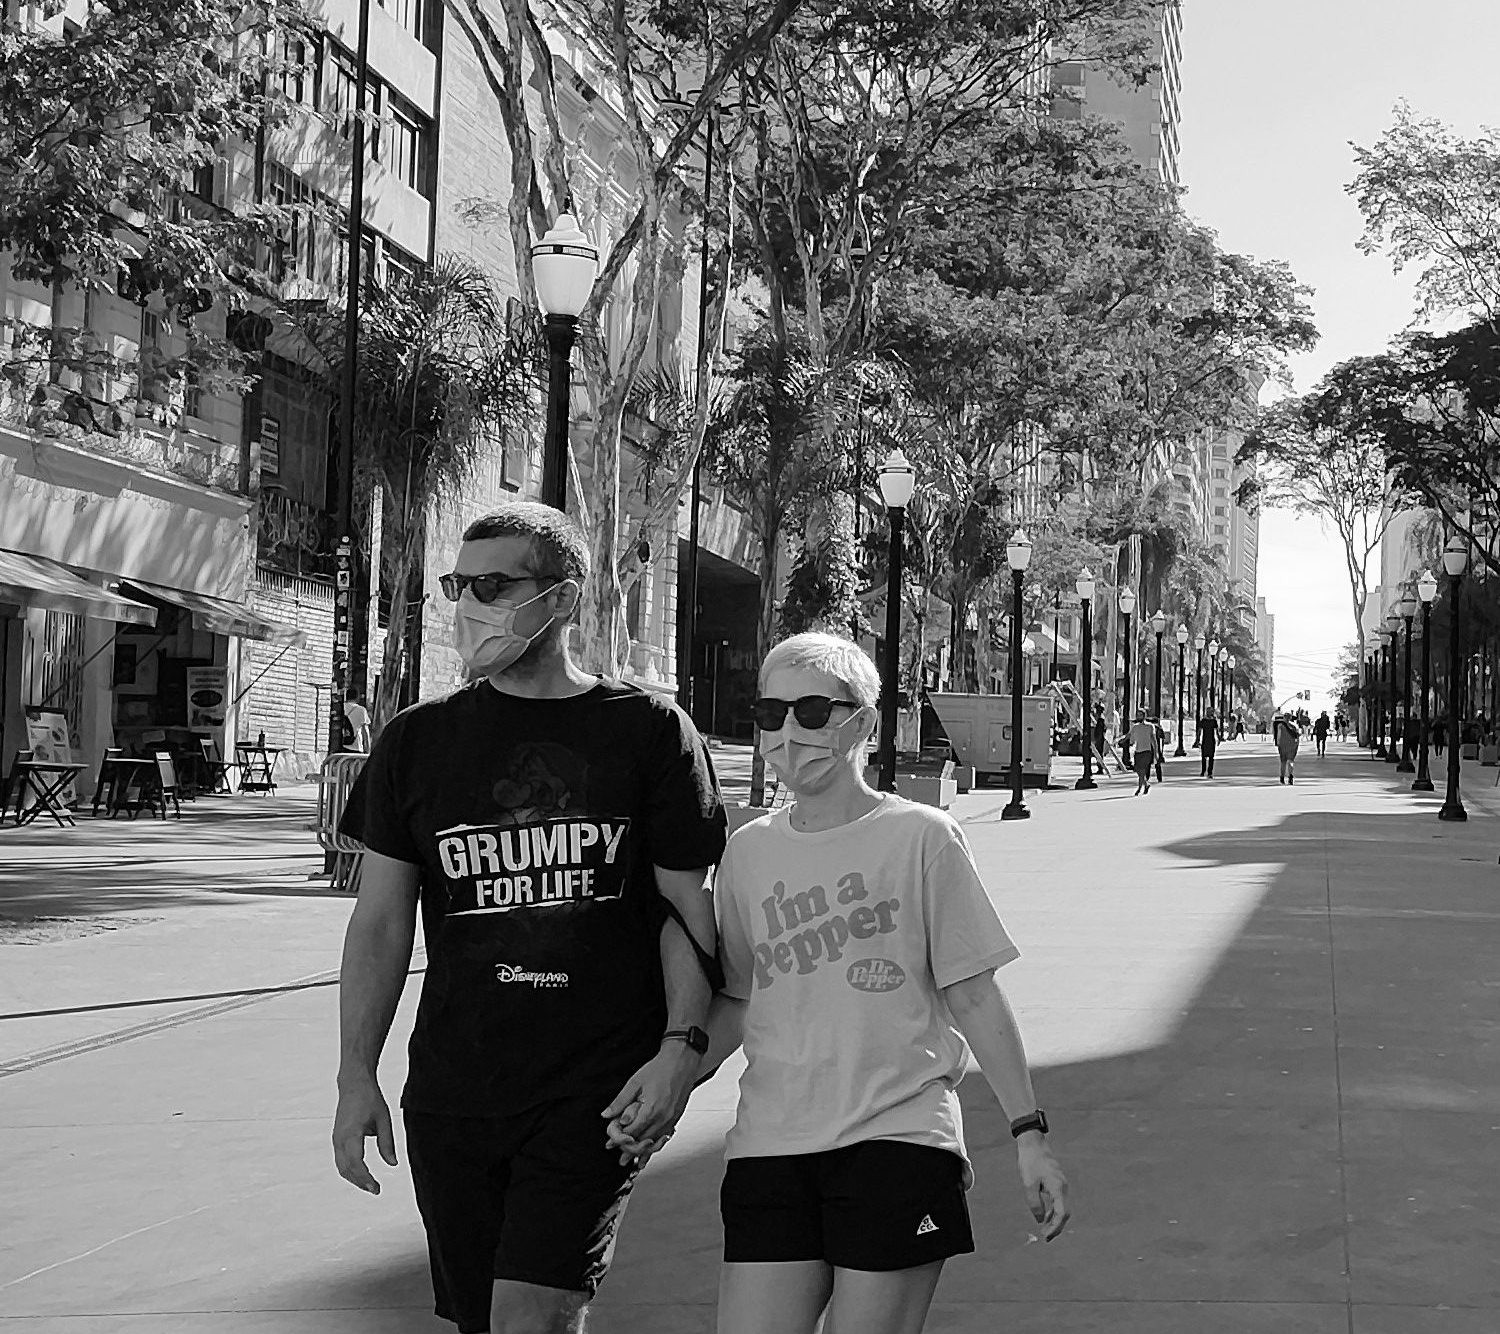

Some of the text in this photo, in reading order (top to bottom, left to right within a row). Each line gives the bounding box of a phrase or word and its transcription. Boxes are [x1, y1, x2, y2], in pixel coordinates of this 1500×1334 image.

[438, 823, 626, 880] GRUMPY
[476, 868, 596, 907] FOR LIFE
[761, 872, 869, 940] I'm a
